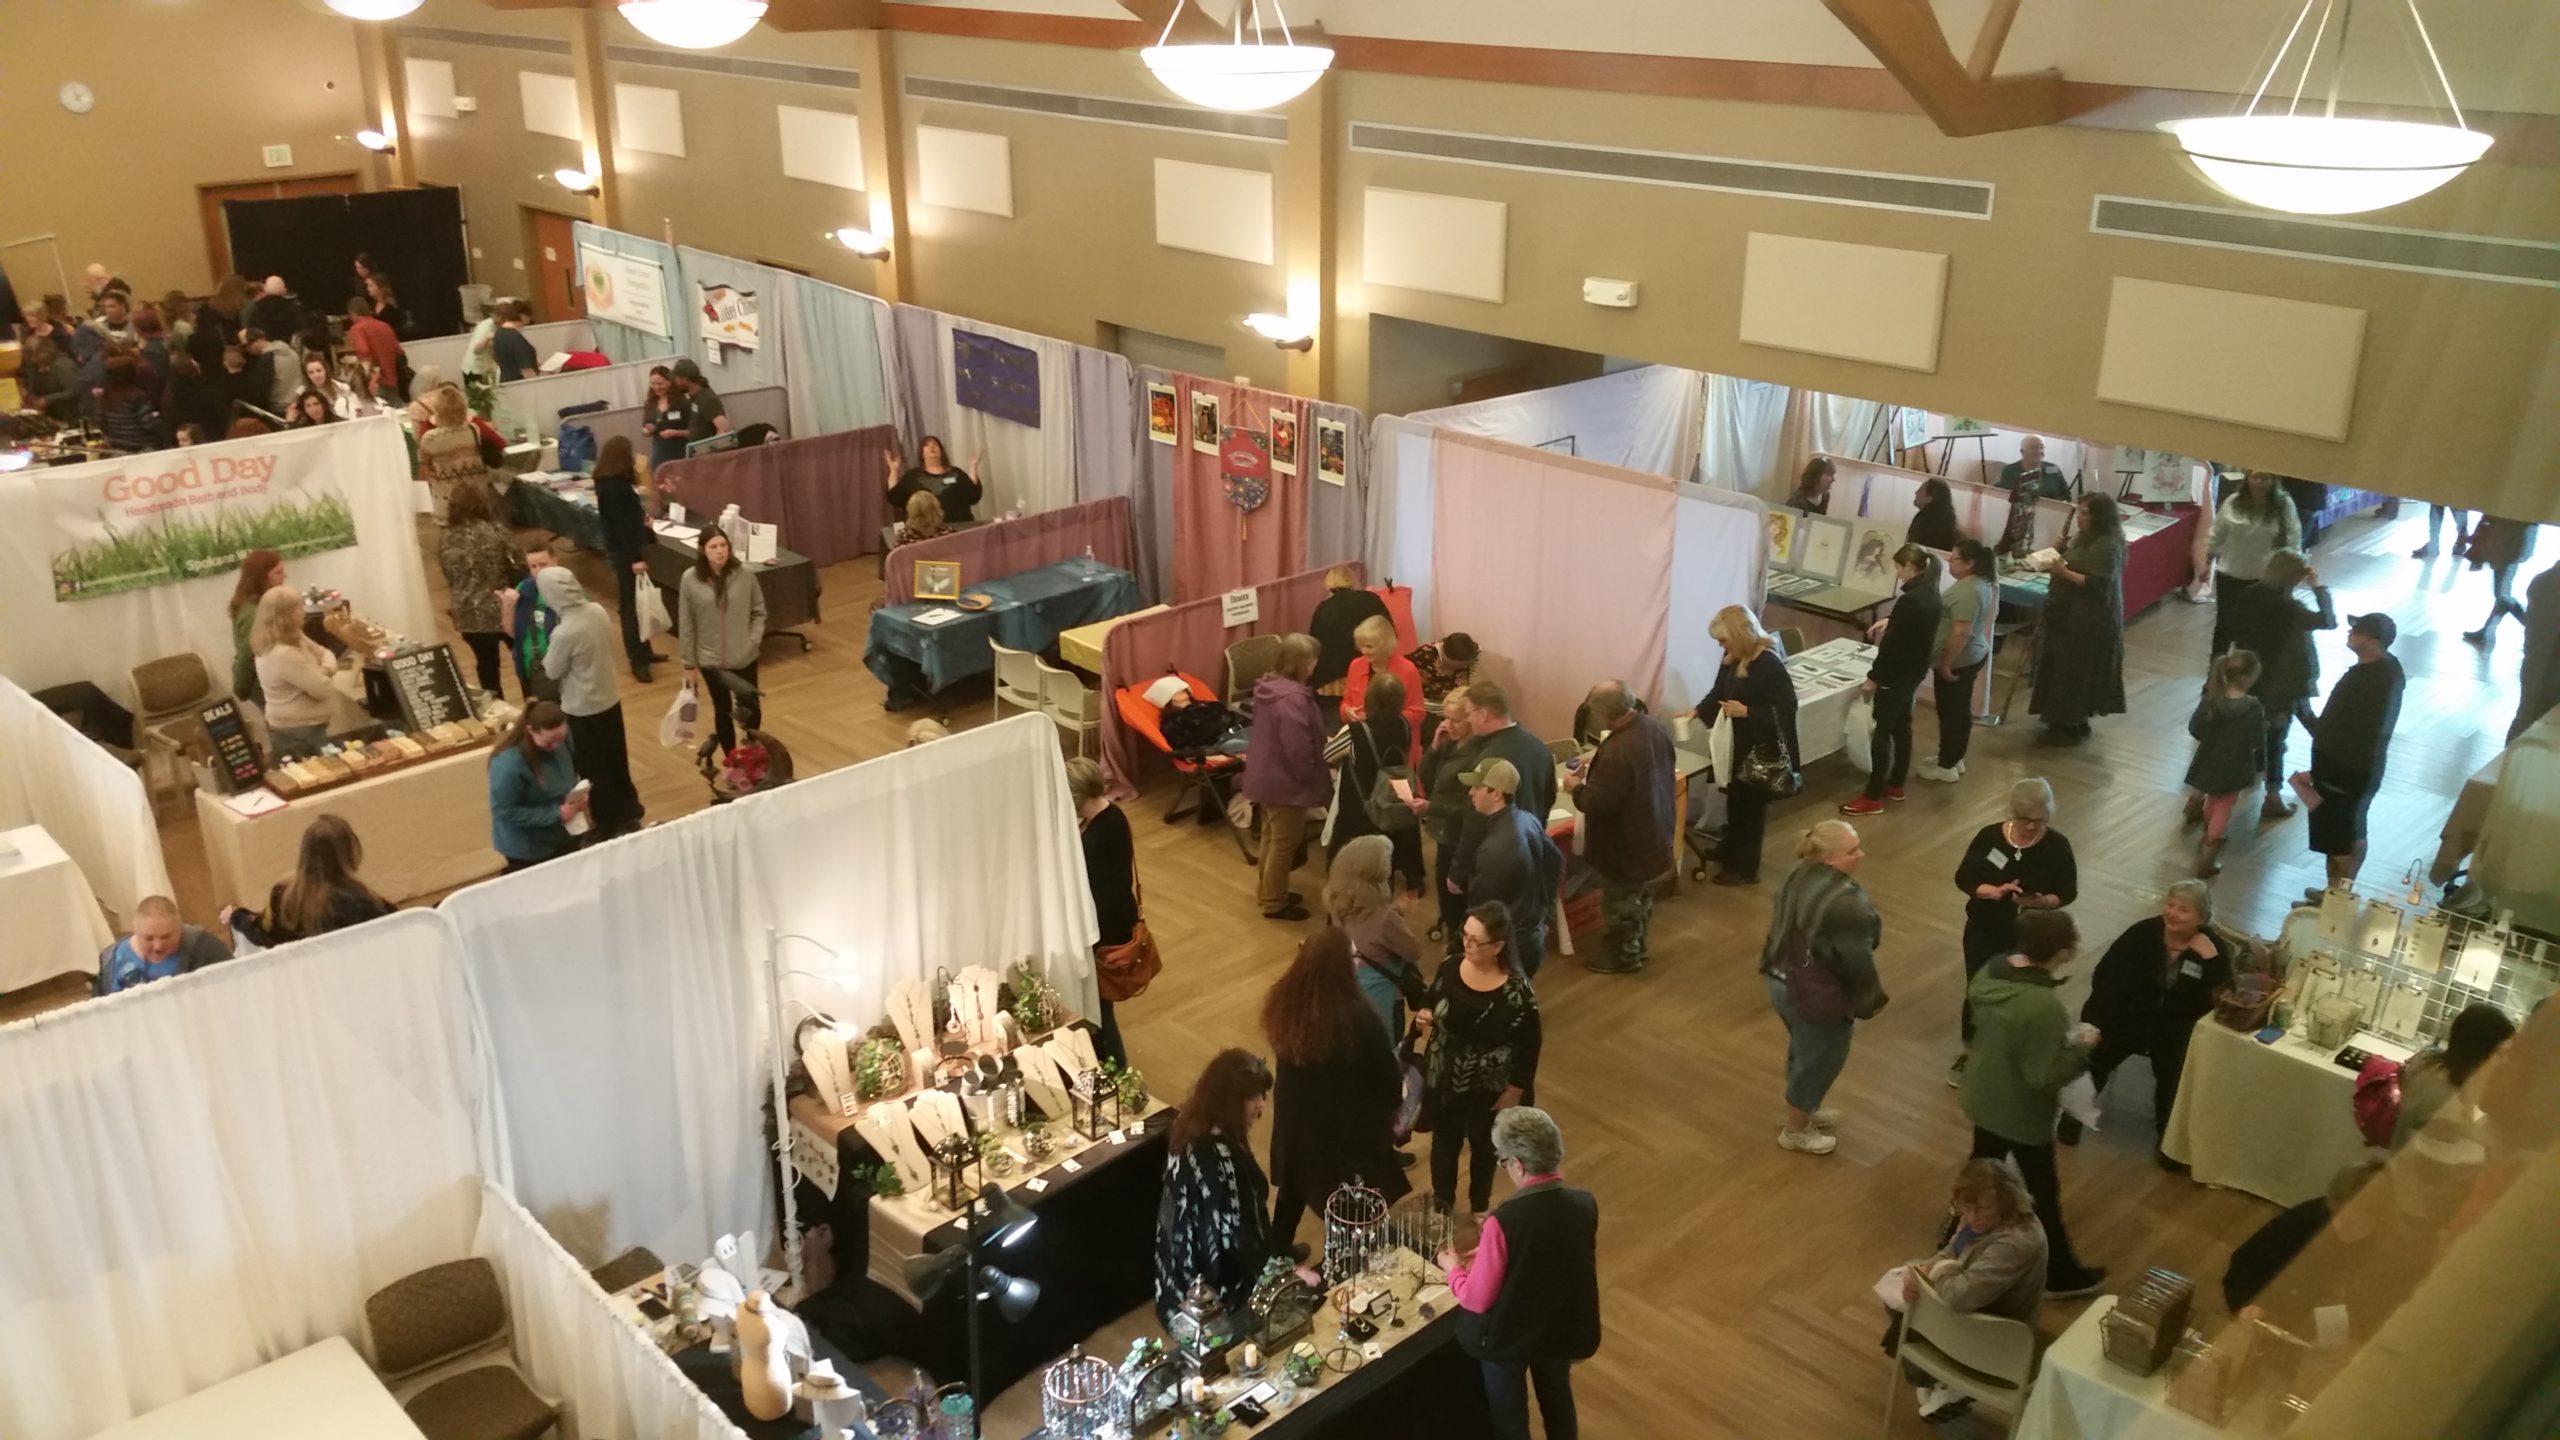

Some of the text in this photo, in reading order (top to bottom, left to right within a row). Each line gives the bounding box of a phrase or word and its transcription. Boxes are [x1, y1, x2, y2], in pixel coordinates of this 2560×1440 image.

[103, 456, 277, 502] Good Day
[392, 656, 416, 669] GOOD
[417, 652, 434, 663] DAY
[203, 703, 233, 722] DEALS
